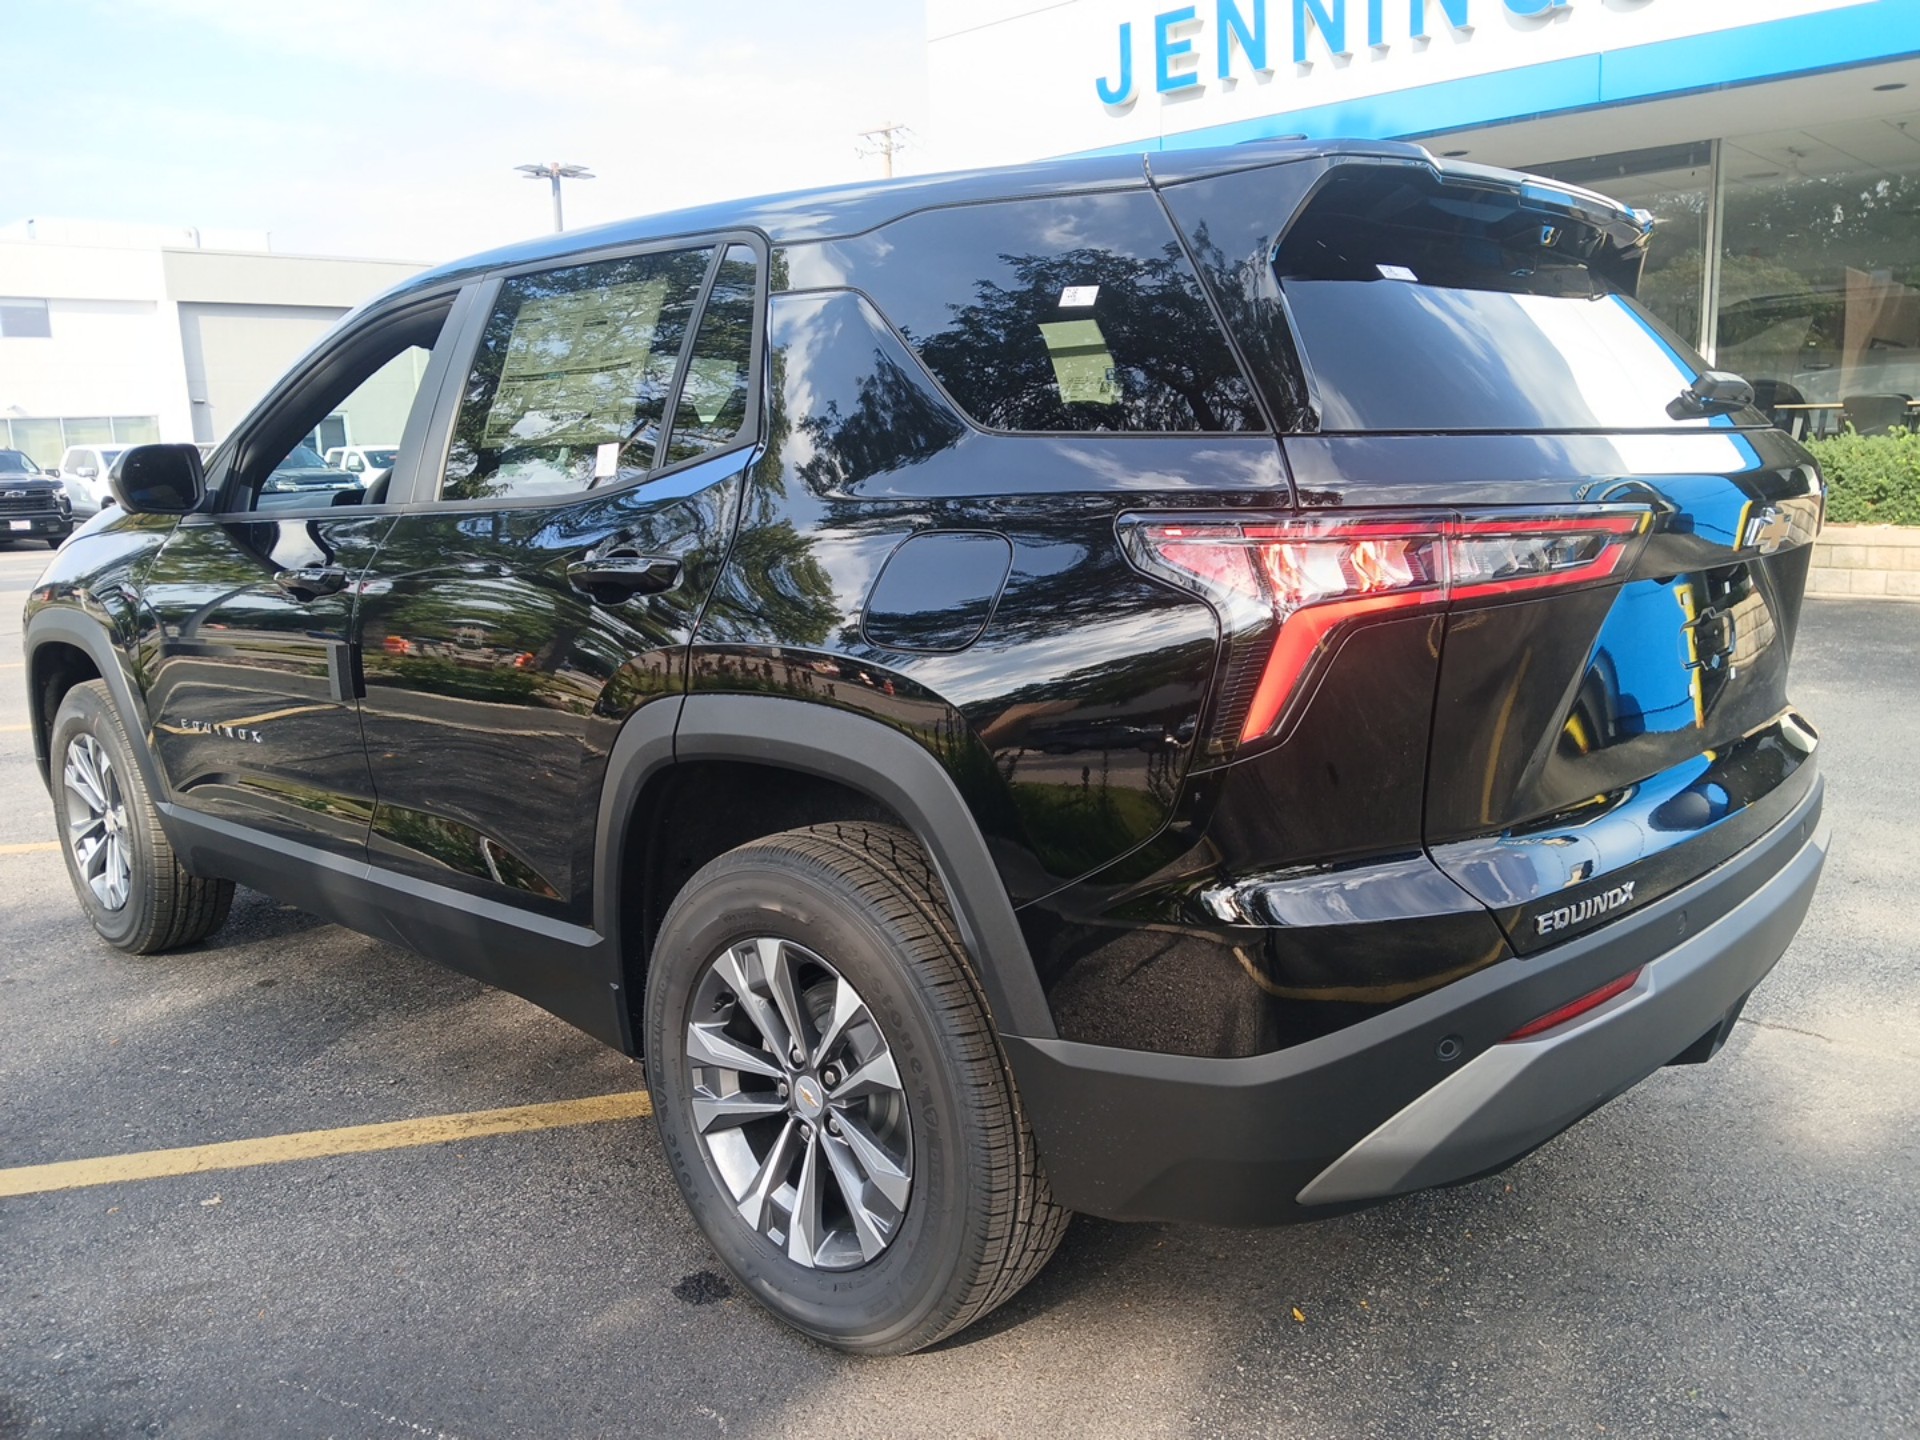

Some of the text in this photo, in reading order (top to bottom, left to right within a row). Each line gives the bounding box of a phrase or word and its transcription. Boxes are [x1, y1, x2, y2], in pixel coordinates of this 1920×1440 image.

[1095, 0, 1568, 105] JENNI
[181, 718, 263, 743] EQUINOX
[1534, 881, 1635, 935] EQUINOX
